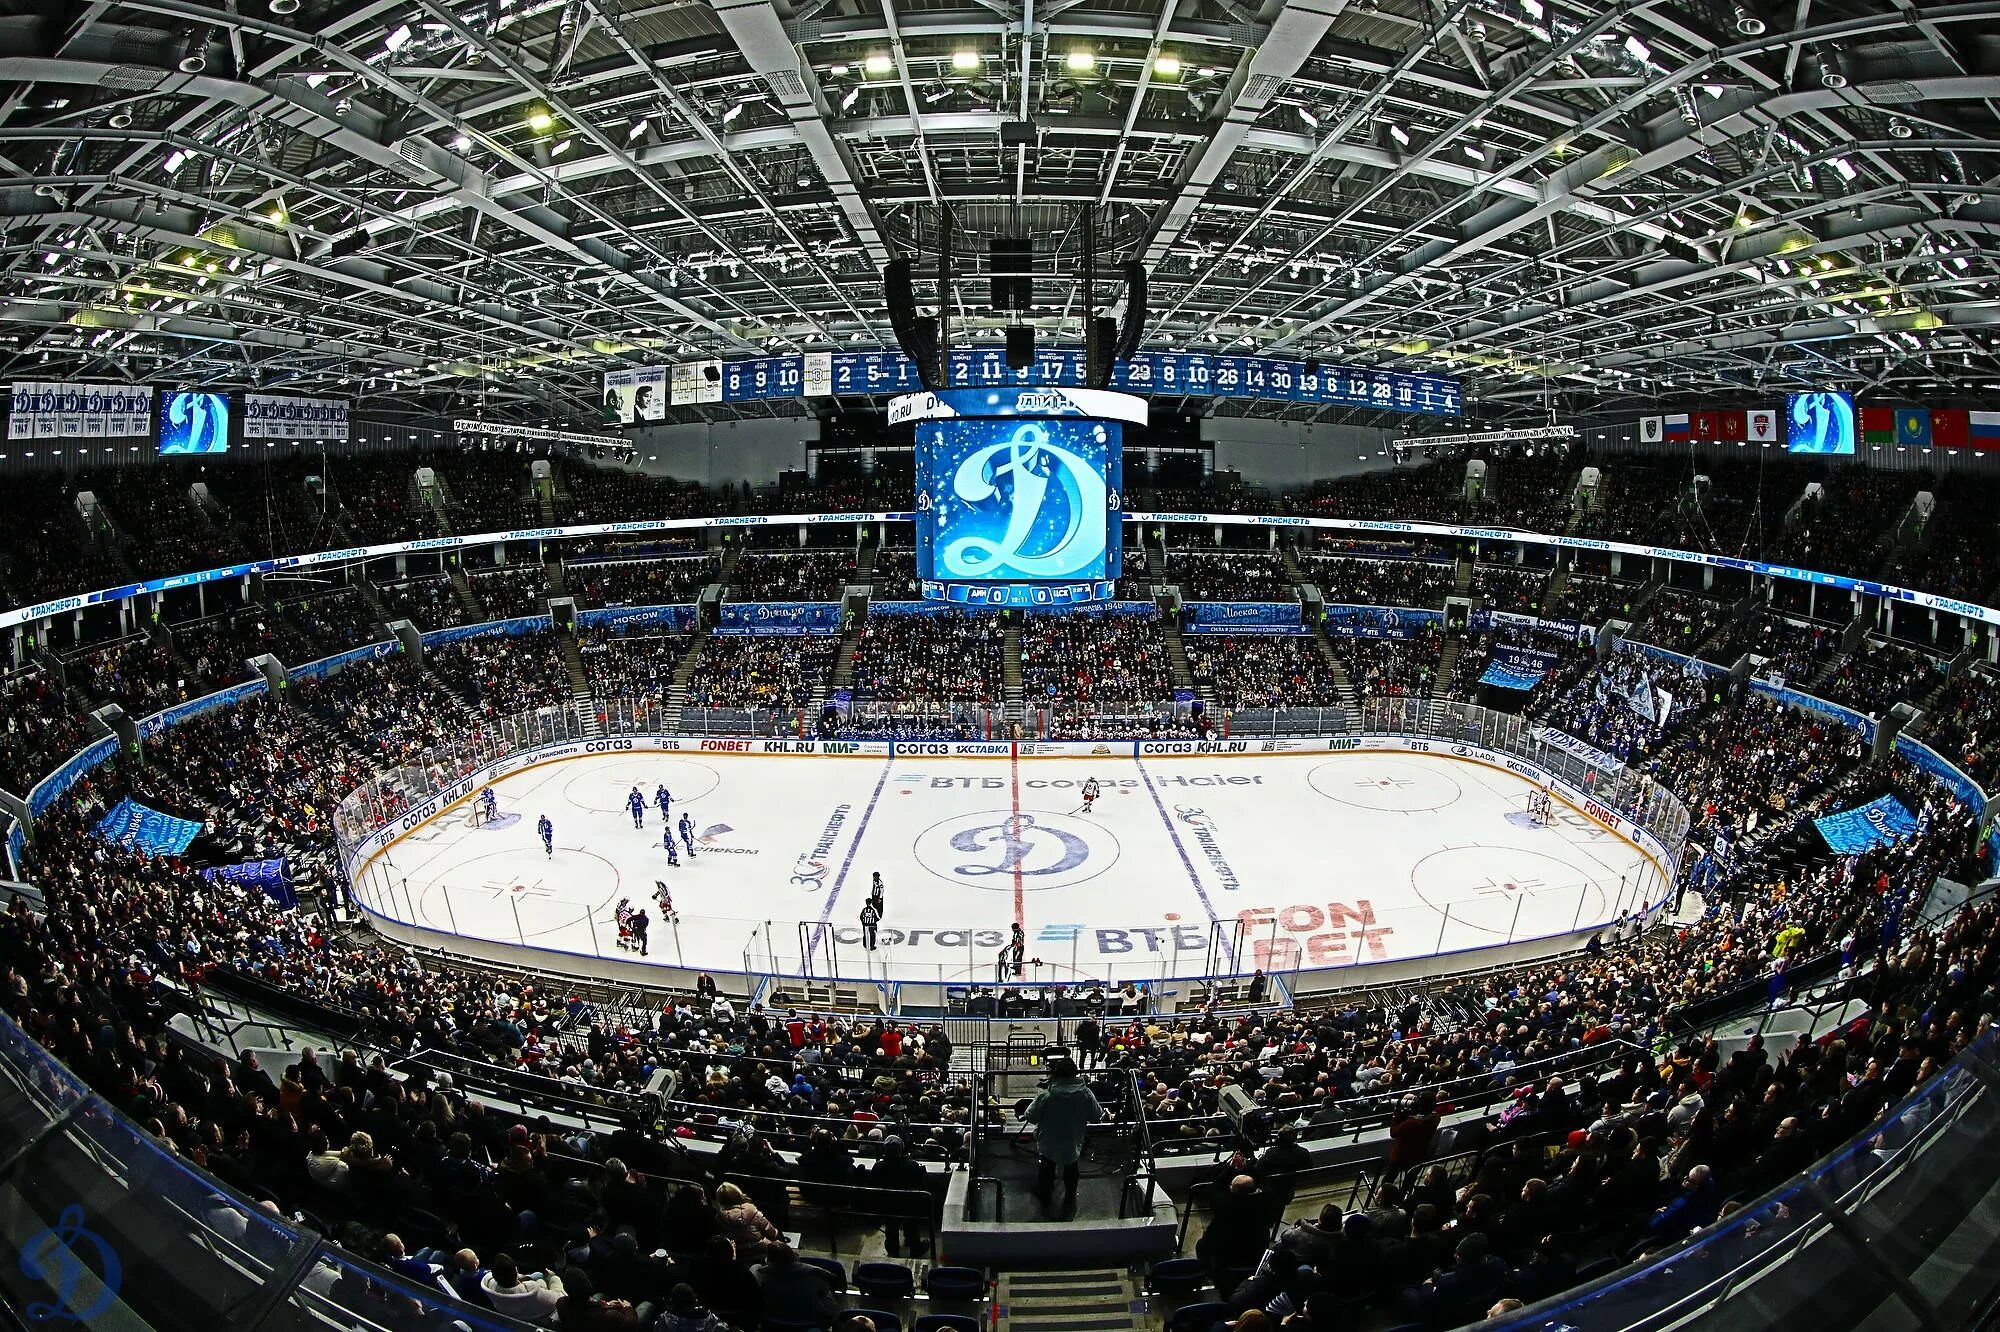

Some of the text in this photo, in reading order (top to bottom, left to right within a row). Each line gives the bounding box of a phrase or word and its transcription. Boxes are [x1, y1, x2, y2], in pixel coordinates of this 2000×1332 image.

[780, 369, 799, 386] 10
[838, 366, 851, 382] 2
[867, 365, 879, 381] 5
[898, 364, 908, 380] 1
[955, 363, 968, 379] 2
[982, 362, 1002, 379] 11
[1041, 362, 1063, 379] 17
[1163, 366, 1175, 382] 8
[1188, 366, 1209, 383] 10
[1217, 369, 1239, 385] 26
[730, 374, 740, 390] 8
[755, 372, 767, 387] 9
[1246, 369, 1265, 387] 14
[1271, 372, 1292, 389] 30
[1327, 377, 1338, 393] 6
[1348, 379, 1367, 396] 12
[1372, 382, 1392, 399] 28
[1398, 387, 1411, 402] 10
[714, 516, 768, 525] ТРАНСНЕФТЬ
[818, 513, 875, 522] ТРАНСНЕФТЬ
[1151, 513, 1208, 522] ТРАНСНЕФТЬ
[1257, 517, 1310, 525] ТРАНСНЕФТЬ
[612, 521, 666, 532] ТРАНСНЕФТЬ
[1358, 521, 1412, 531] ТРАНСНЕФТЬ
[510, 529, 563, 539] ТРАНСНЕФТЬ
[1459, 528, 1512, 539] ТРАНСНЕФТЬ
[411, 537, 463, 549] ТРАНСНЕФТЬ
[1558, 537, 1610, 549] ТРАНСНЕФТЬ
[316, 549, 368, 562] ТРАНСНЕФТЬ
[1652, 548, 1703, 562] ТРАНСНЕФТЬ
[971, 589, 986, 598] ДИН
[993, 590, 1001, 602] 0
[1037, 590, 1046, 602] 0
[1053, 589, 1069, 597] ЦСК
[30, 597, 82, 618] ТРАНСНЕФТЬ
[1104, 602, 1123, 611] 1946
[1223, 606, 1258, 618] Москва
[1934, 597, 1985, 618] ТРАНСНЕФТЬ
[613, 612, 658, 626] MOSCOW
[1539, 619, 1576, 633] DYNAMO
[1508, 655, 1543, 669] 19 46
[662, 741, 680, 750] ВТБ
[700, 740, 753, 752] FONBET
[764, 741, 815, 753] KHL.RU
[823, 742, 860, 754] МИР
[1197, 741, 1248, 753] KHL.RU
[1328, 738, 1362, 750] МИР
[1411, 741, 1429, 751] ВТБ
[538, 747, 578, 760] ТРАНСНЕФТЬ
[1474, 751, 1496, 763] LADA
[930, 776, 1005, 789] ВТБ
[1156, 773, 1263, 787] Haier
[442, 780, 475, 808] KHL.RU
[1583, 799, 1622, 831] FONBET
[380, 828, 396, 847] ВТБ
[808, 803, 852, 860] ТРАНСНЕФТЬ
[1192, 826, 1240, 891] ТРАНСНЕФТЬ
[1237, 899, 1377, 936] FON
[1096, 925, 1210, 954] ВТБ
[1253, 927, 1393, 972] BET
